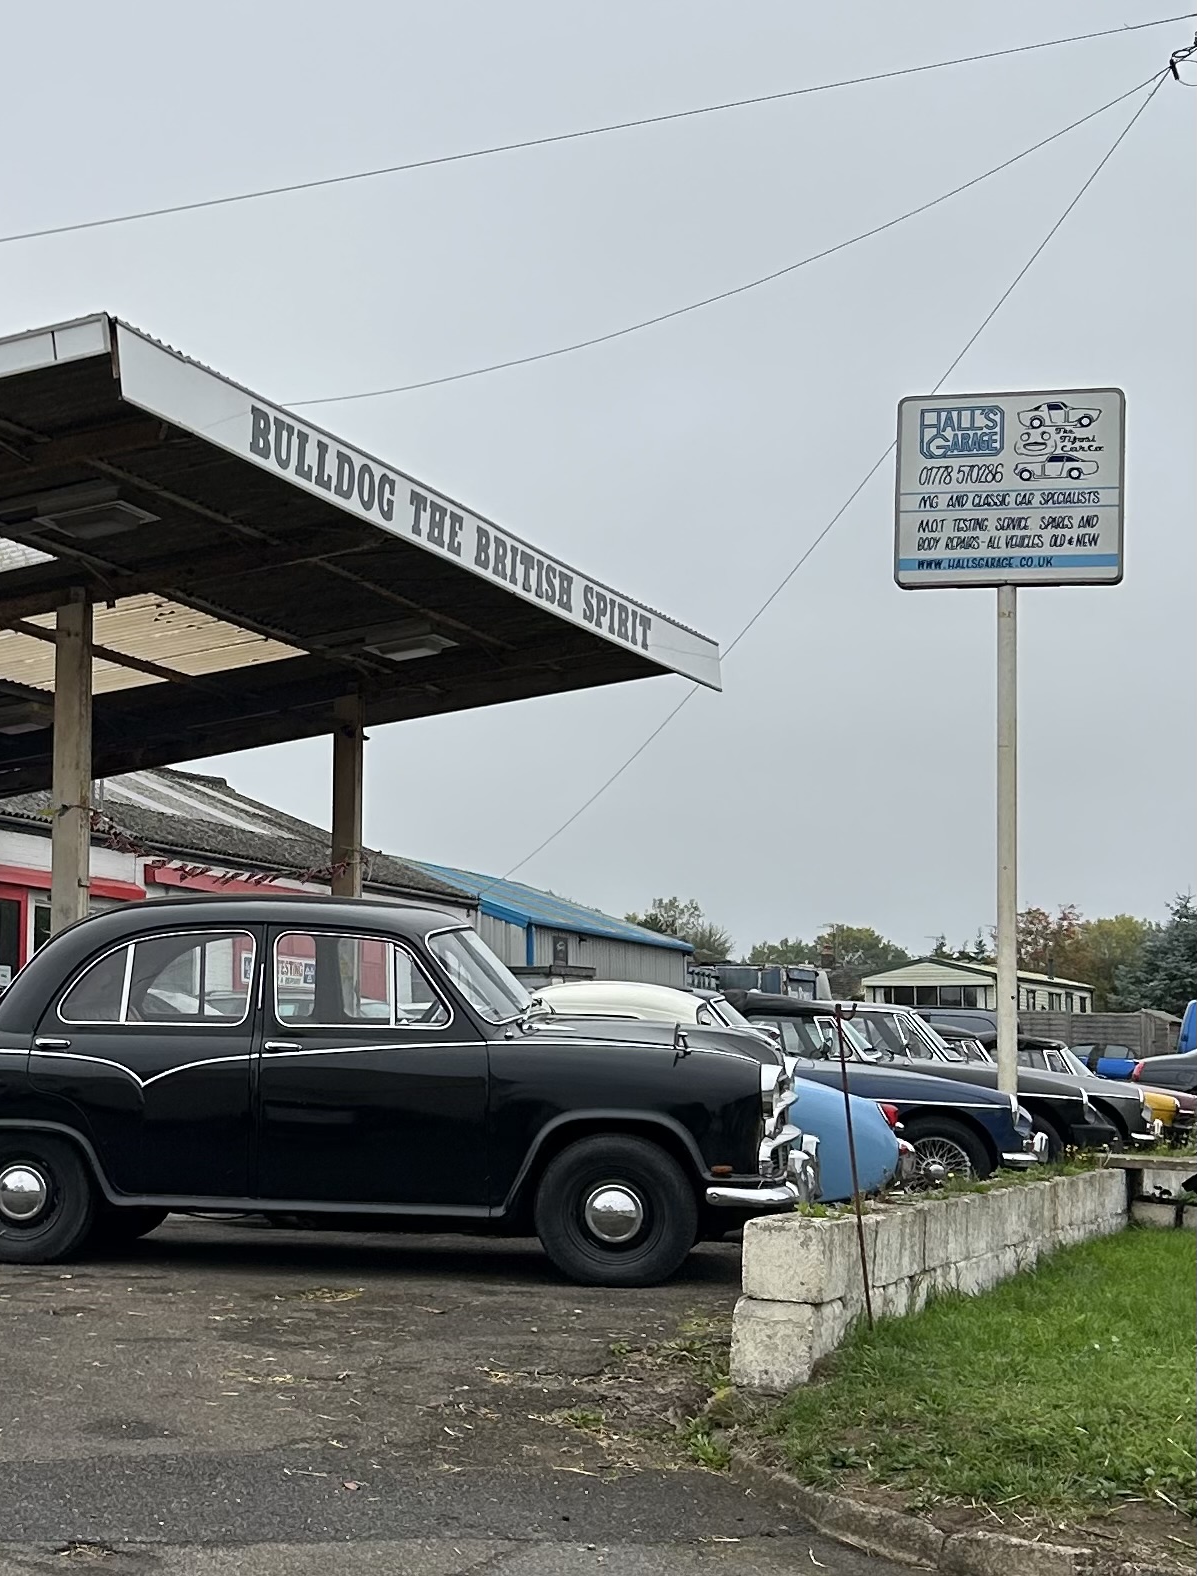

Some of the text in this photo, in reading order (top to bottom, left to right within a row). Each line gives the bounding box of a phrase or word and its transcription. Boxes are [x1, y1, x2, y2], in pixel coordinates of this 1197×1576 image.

[920, 407, 999, 435] HALL'S
[926, 432, 998, 459] GARAGE
[919, 462, 1004, 485] 01778 570286
[918, 490, 1100, 509] MG AND CLASSIC CAR SPECIALISTS
[250, 404, 652, 651] BULLDOG THE BRITISH SPIRIT
[1039, 515, 1074, 530] SPARES
[1078, 514, 1099, 529] AND
[917, 536, 941, 551] BODY
[1005, 534, 1044, 549] VEHICLES
[1049, 533, 1066, 548] OLD
[1075, 533, 1100, 547] NEW
